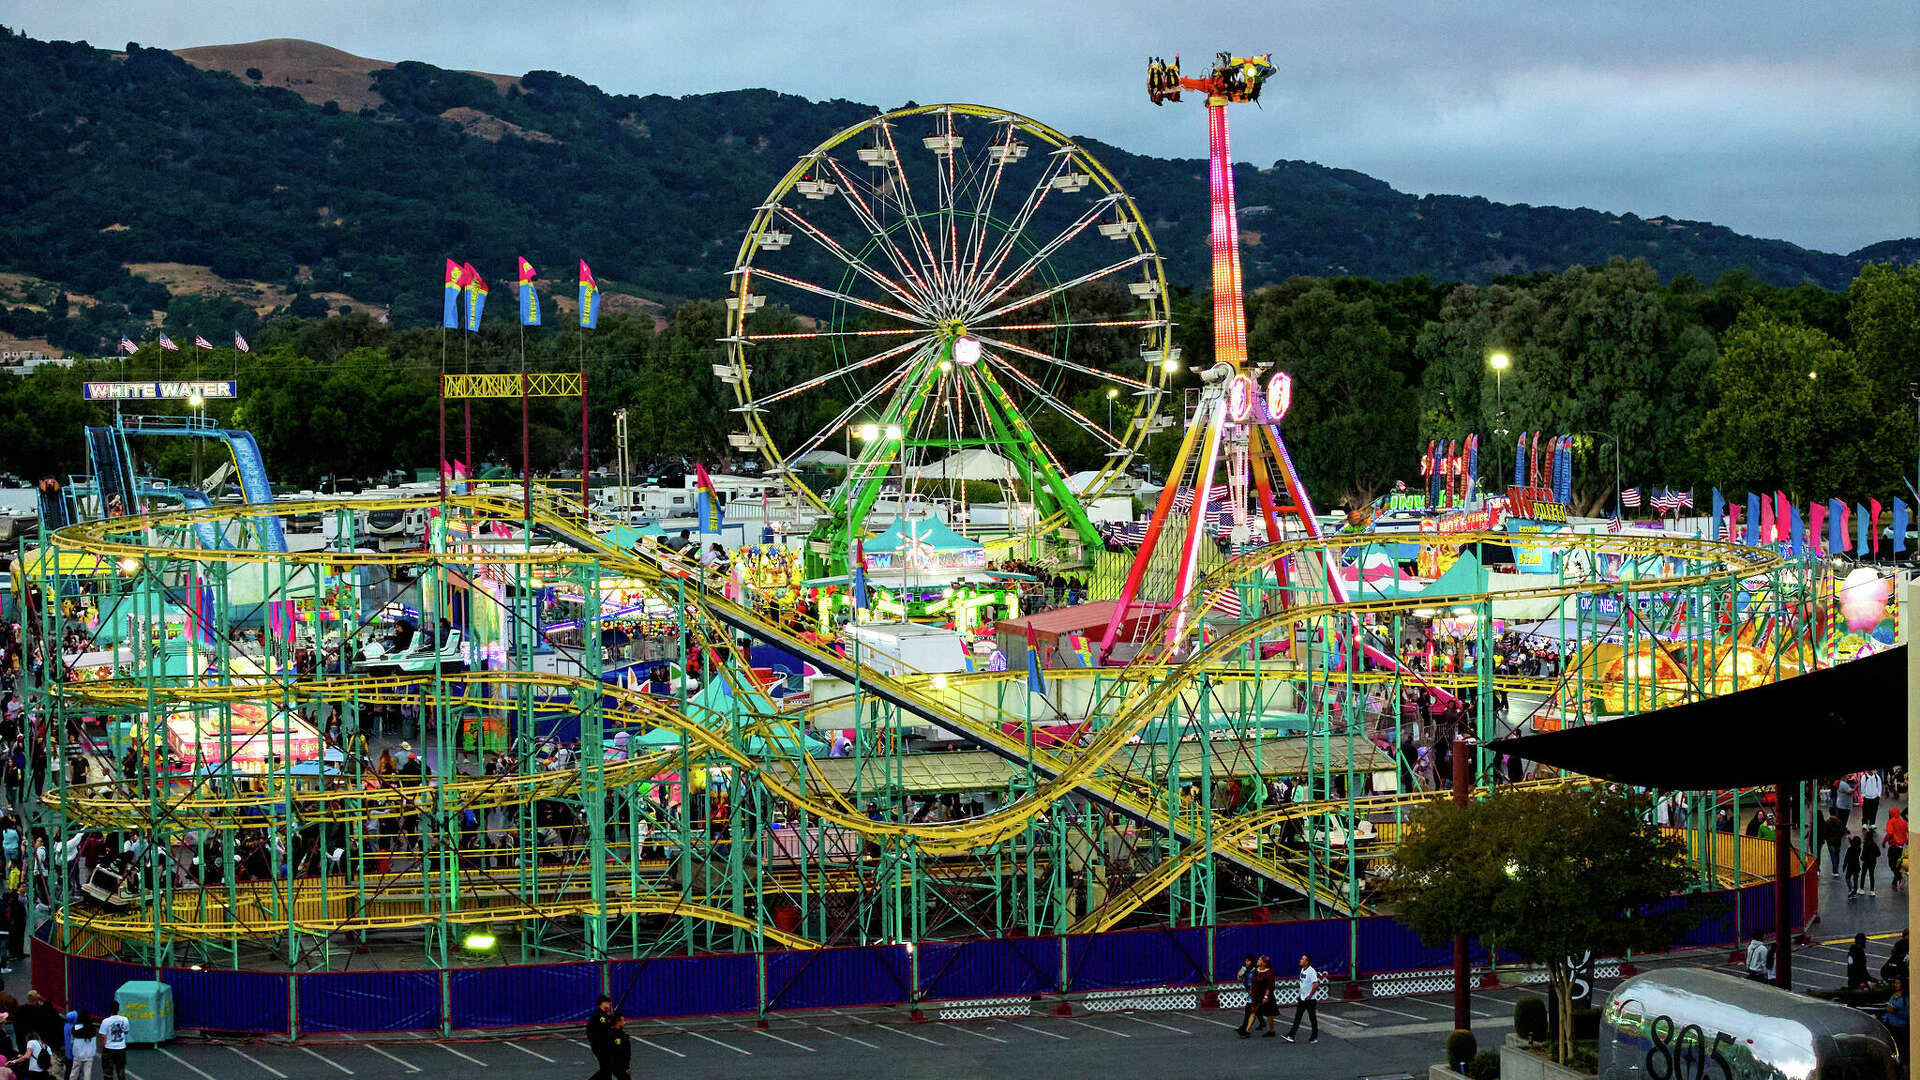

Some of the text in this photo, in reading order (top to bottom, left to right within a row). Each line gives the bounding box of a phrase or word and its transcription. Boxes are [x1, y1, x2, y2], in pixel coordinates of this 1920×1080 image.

[88, 382, 232, 399] WHITE WATER
[1646, 1015, 1736, 1080] 805
